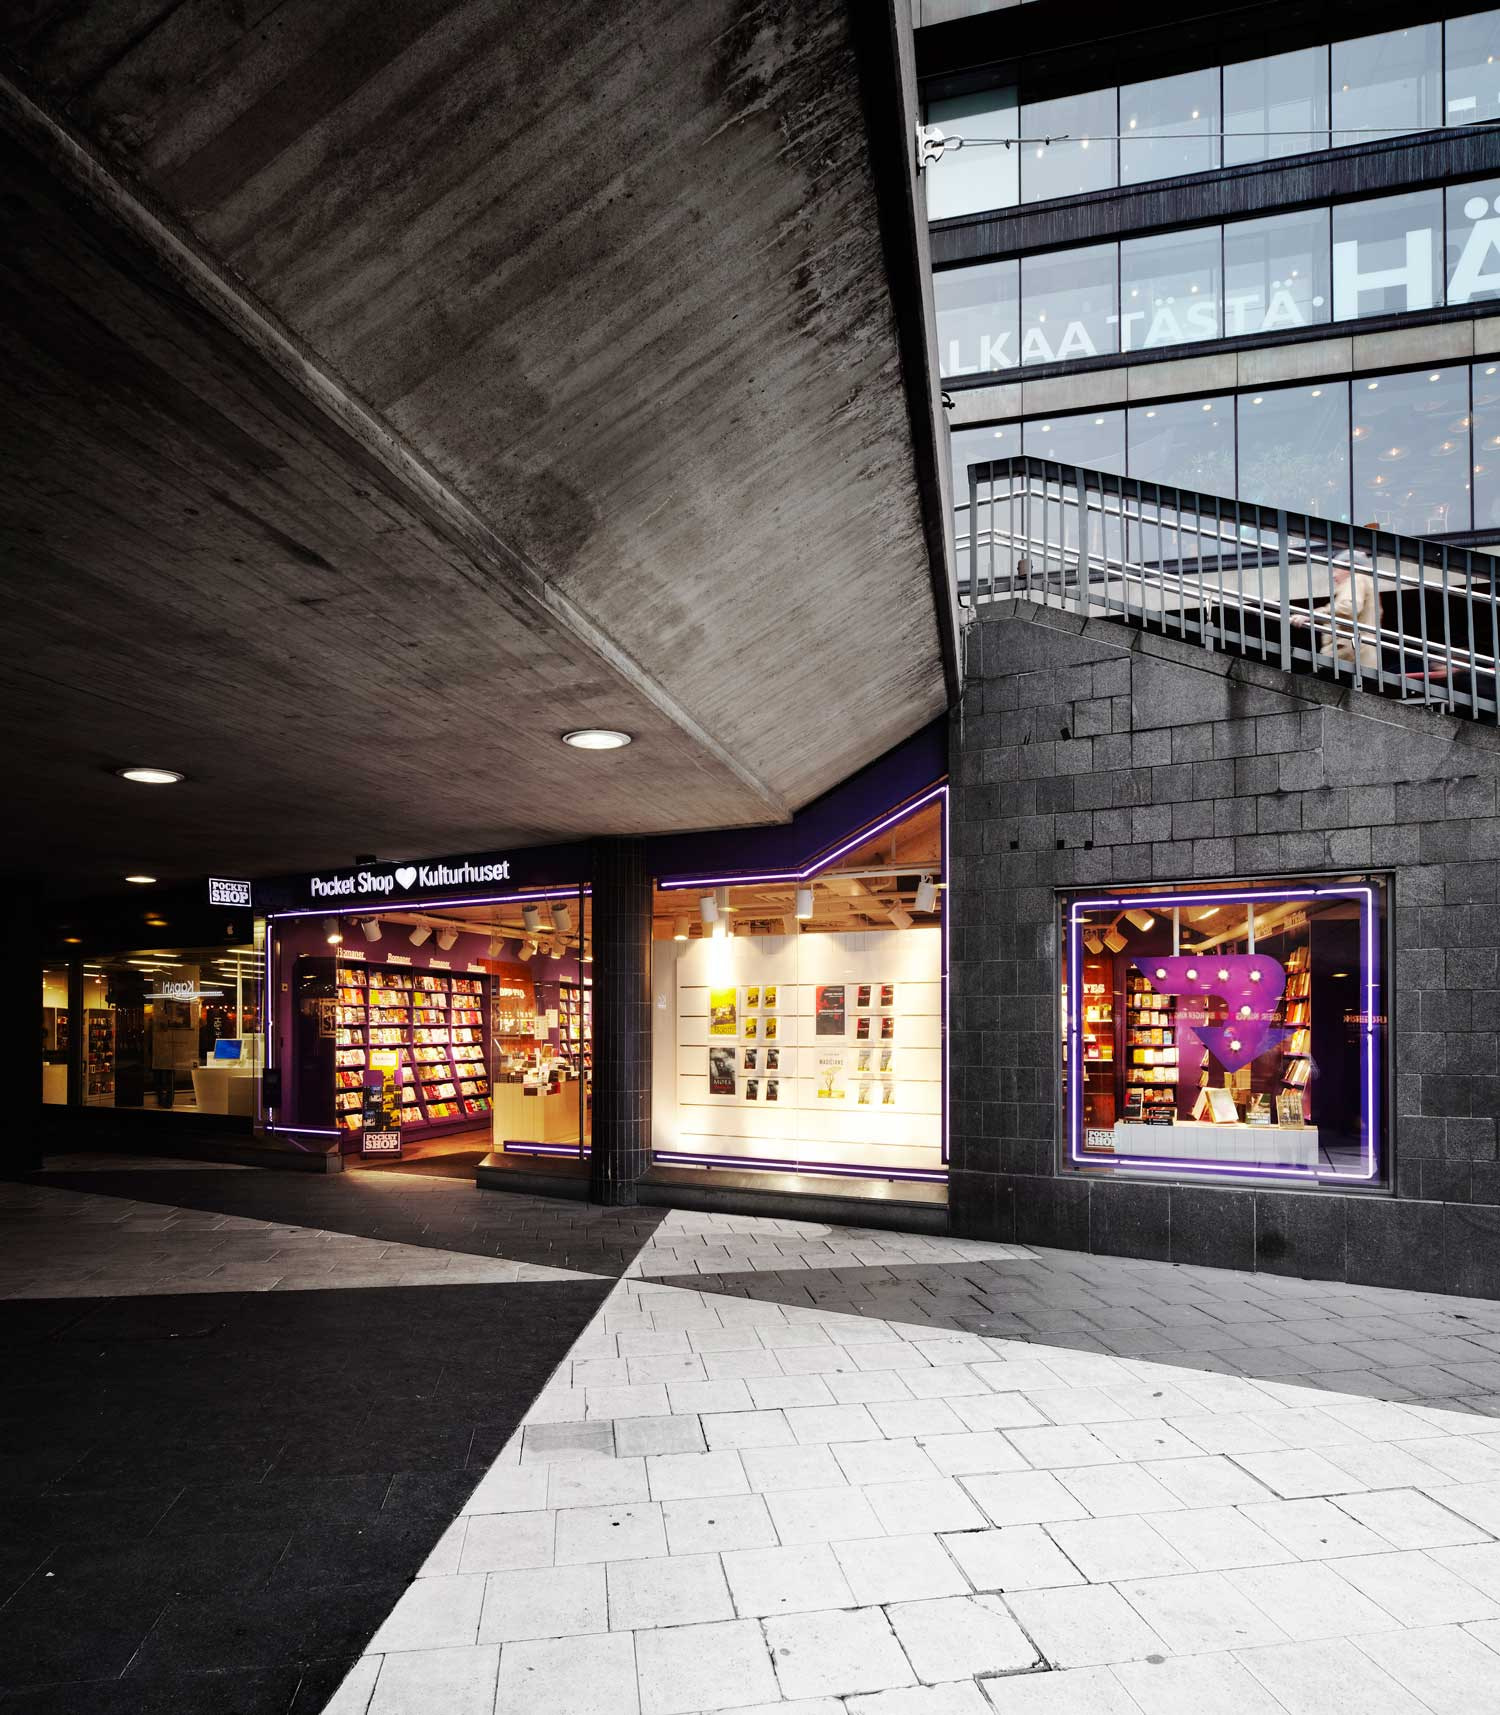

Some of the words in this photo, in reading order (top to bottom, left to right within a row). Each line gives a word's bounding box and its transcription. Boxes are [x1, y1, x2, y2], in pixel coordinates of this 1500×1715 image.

[1105, 279, 1305, 353] TÄSTÄ
[310, 876, 356, 897] Pocket
[357, 872, 394, 895] Shop
[419, 860, 510, 887] Kulturhuset
[212, 881, 248, 892] POCKET
[212, 889, 249, 904] SHOP
[365, 1140, 398, 1149] SHOP
